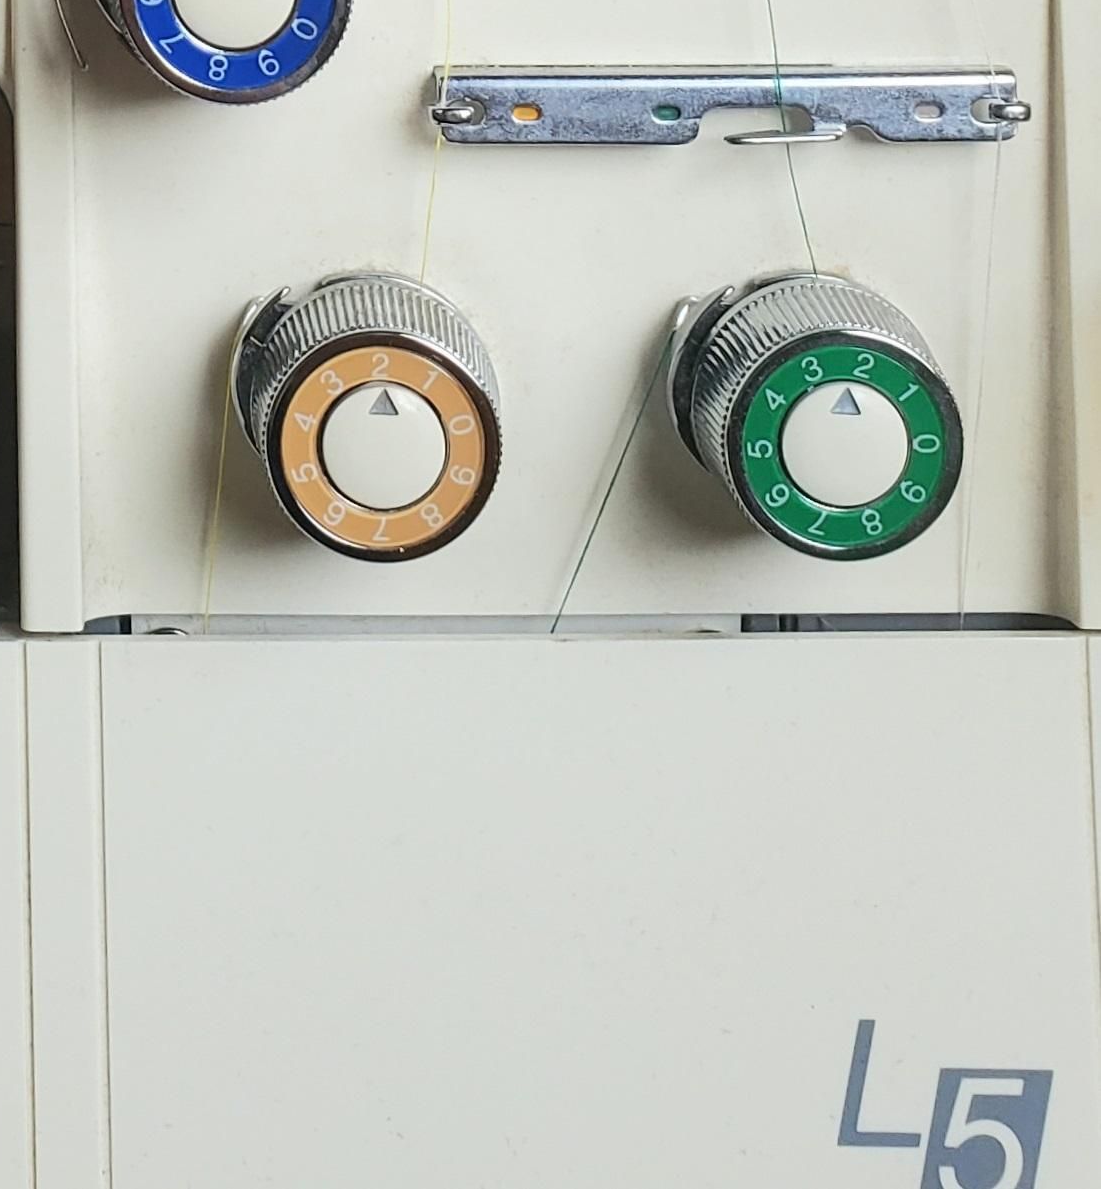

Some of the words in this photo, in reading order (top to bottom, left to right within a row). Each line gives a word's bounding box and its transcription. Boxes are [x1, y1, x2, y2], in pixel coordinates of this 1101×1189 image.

[292, 18, 317, 40] 0
[160, 33, 185, 54] 7
[209, 55, 228, 80] 8
[372, 353, 389, 377] 2
[801, 356, 823, 381] 3
[853, 353, 874, 379] 2
[321, 370, 343, 395] 3
[423, 370, 440, 390] 1
[765, 388, 786, 410] 4
[898, 383, 919, 401] 1
[294, 411, 316, 432] 4
[449, 415, 475, 434] 0
[747, 439, 773, 458] 5
[912, 434, 940, 453] 0
[291, 463, 318, 483] 5
[420, 504, 444, 527] 8
[808, 511, 828, 535] 7
[861, 509, 883, 535] 8
[372, 517, 390, 541] 7
